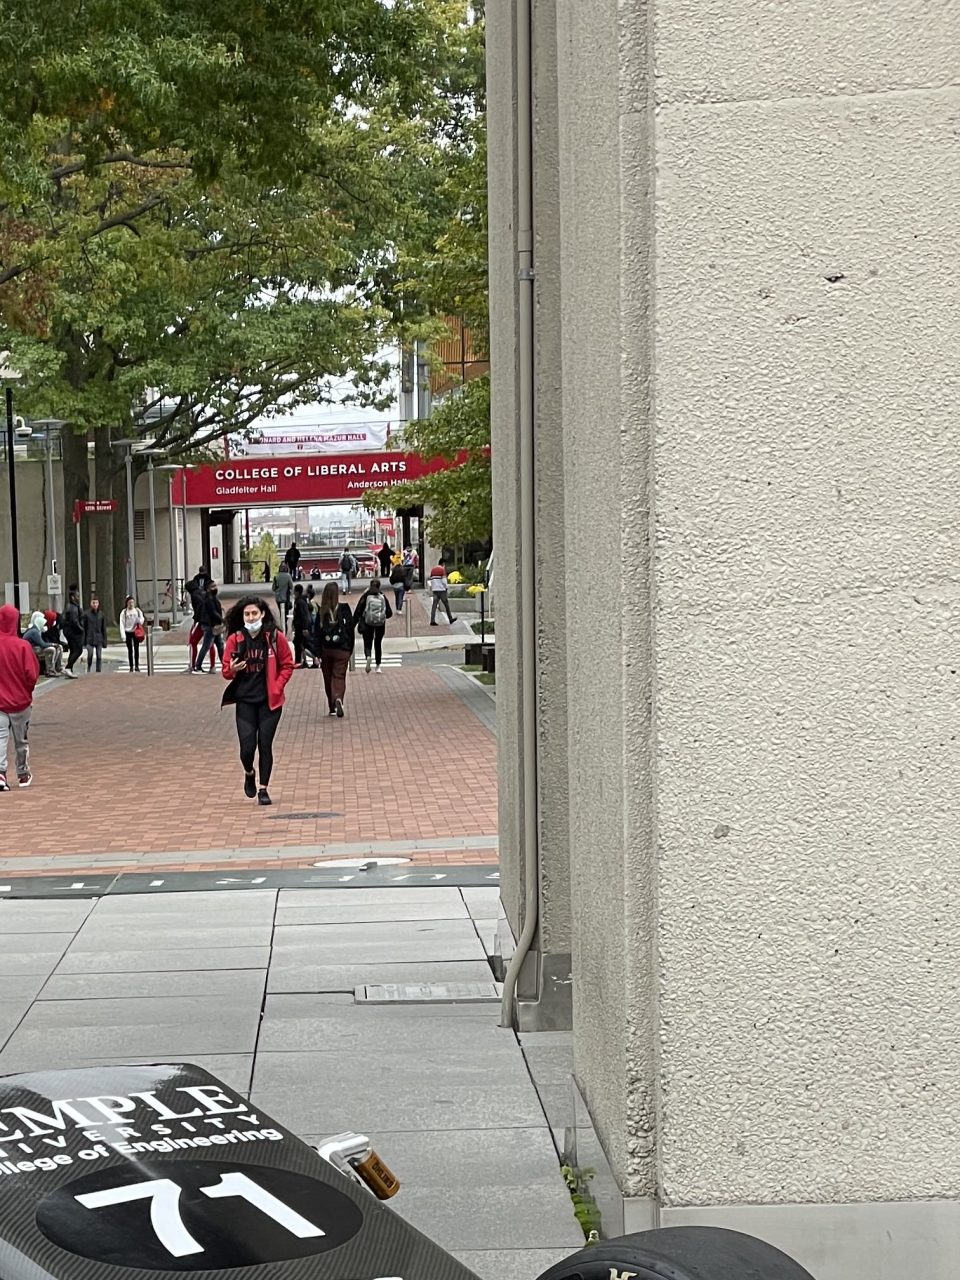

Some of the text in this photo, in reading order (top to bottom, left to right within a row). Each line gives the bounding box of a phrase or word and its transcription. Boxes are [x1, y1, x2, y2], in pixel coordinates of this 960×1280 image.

[215, 461, 407, 481] COLLEGE OF LIBERAL ARTS
[216, 484, 277, 495] Gladfelter Hall
[347, 480, 388, 489] Anderson
[77, 1144, 108, 1161] of
[119, 1127, 283, 1155] Engineering
[73, 1171, 327, 1258] 71
